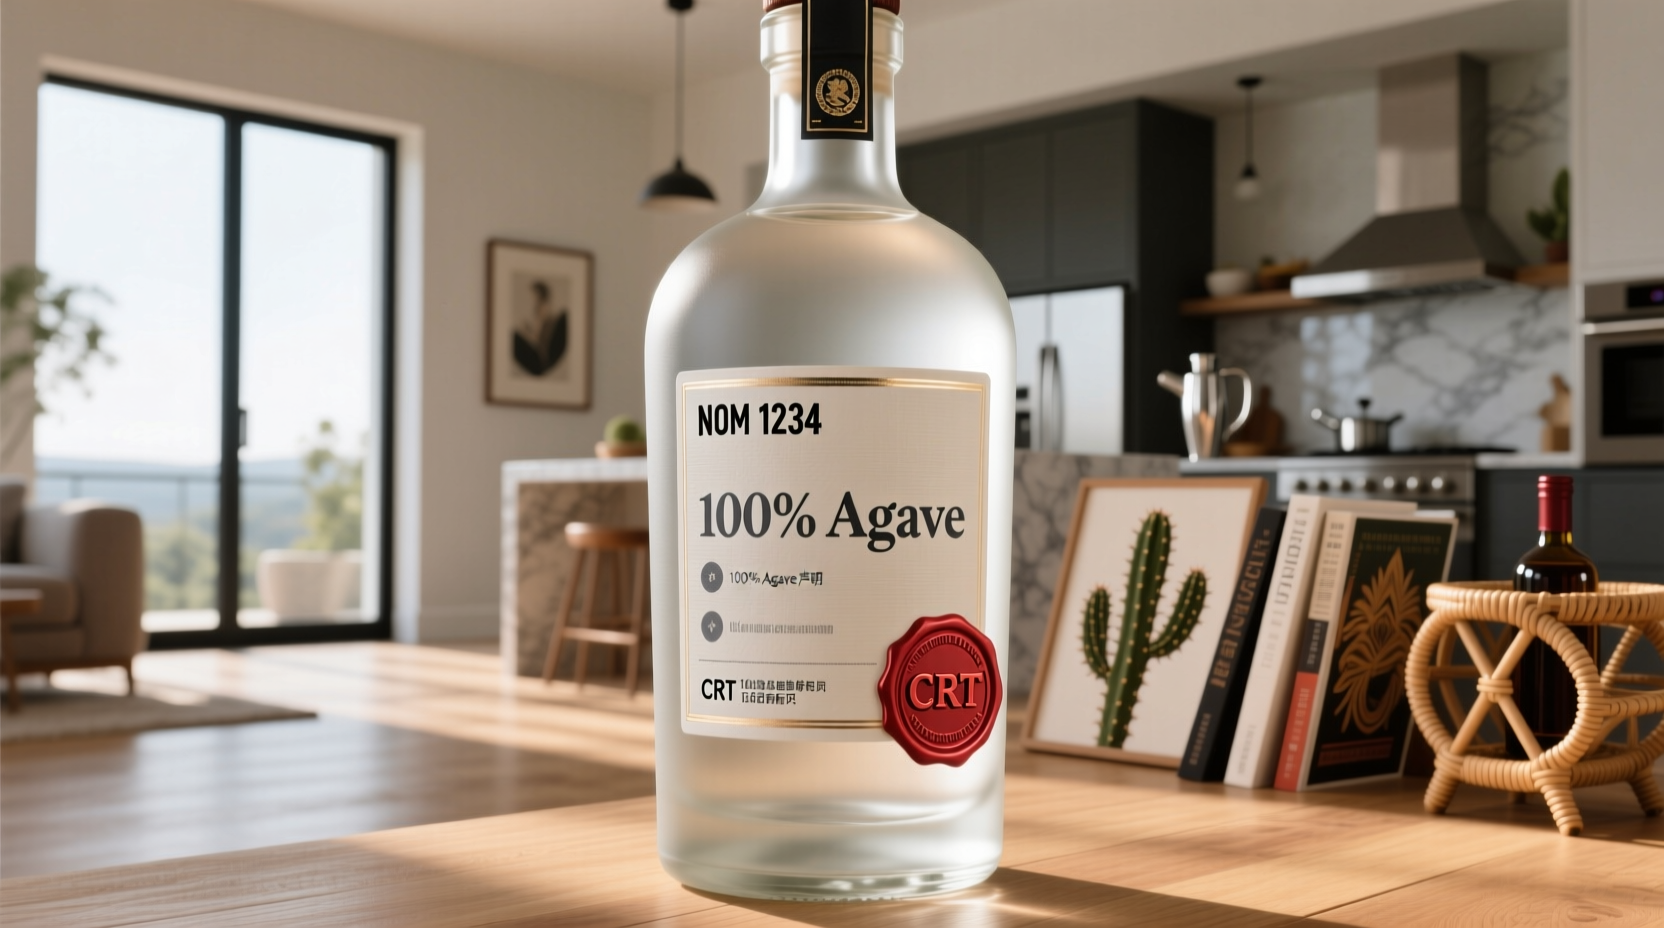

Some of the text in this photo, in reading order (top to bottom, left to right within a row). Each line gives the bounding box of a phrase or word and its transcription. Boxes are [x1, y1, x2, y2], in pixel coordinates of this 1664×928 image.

[698, 402, 822, 436] NOM 1234
[699, 491, 965, 552] 100% Agave
[701, 679, 736, 701] CRT
[908, 672, 983, 709] CRT
